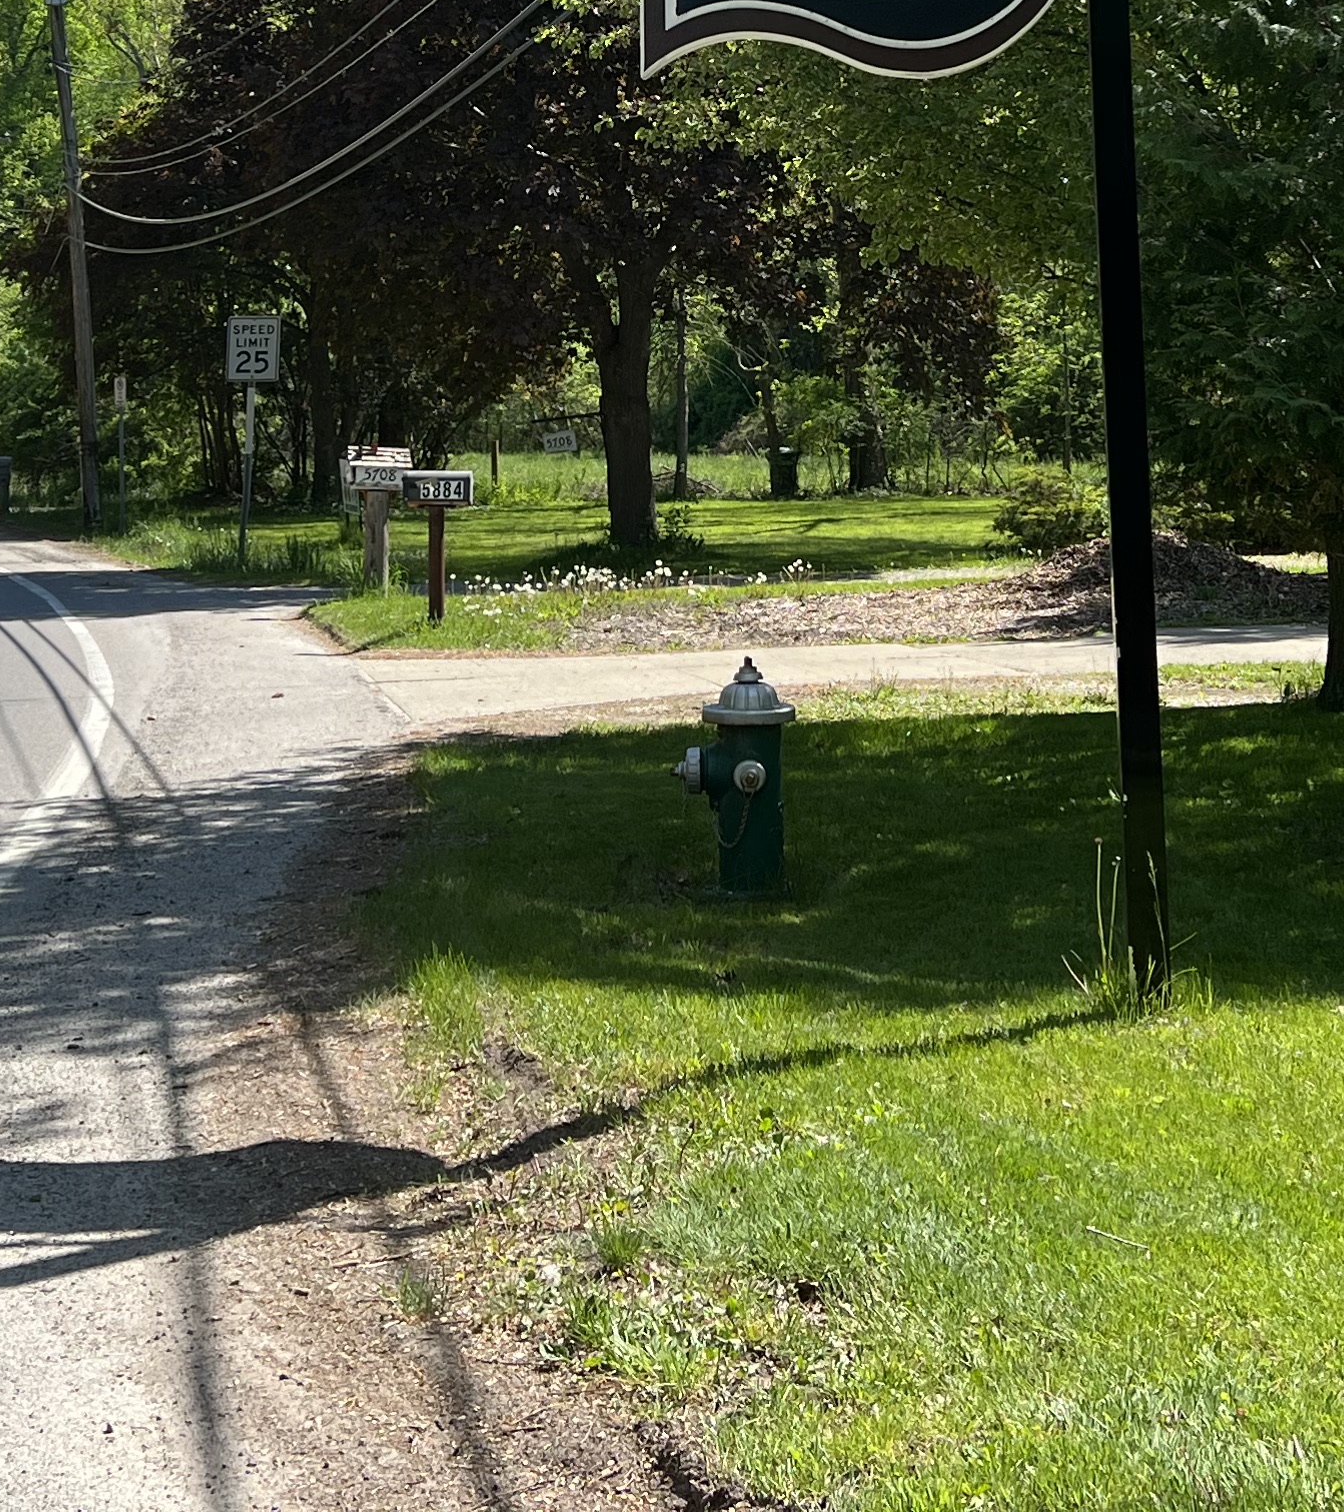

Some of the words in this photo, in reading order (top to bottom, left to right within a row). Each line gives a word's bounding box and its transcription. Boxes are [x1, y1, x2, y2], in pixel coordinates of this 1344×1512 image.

[233, 324, 276, 335] SPEED
[236, 337, 270, 348] LIMIT
[235, 350, 269, 374] 25
[546, 435, 573, 449] 5708
[361, 467, 398, 482] 5708
[421, 481, 463, 498] 5884
